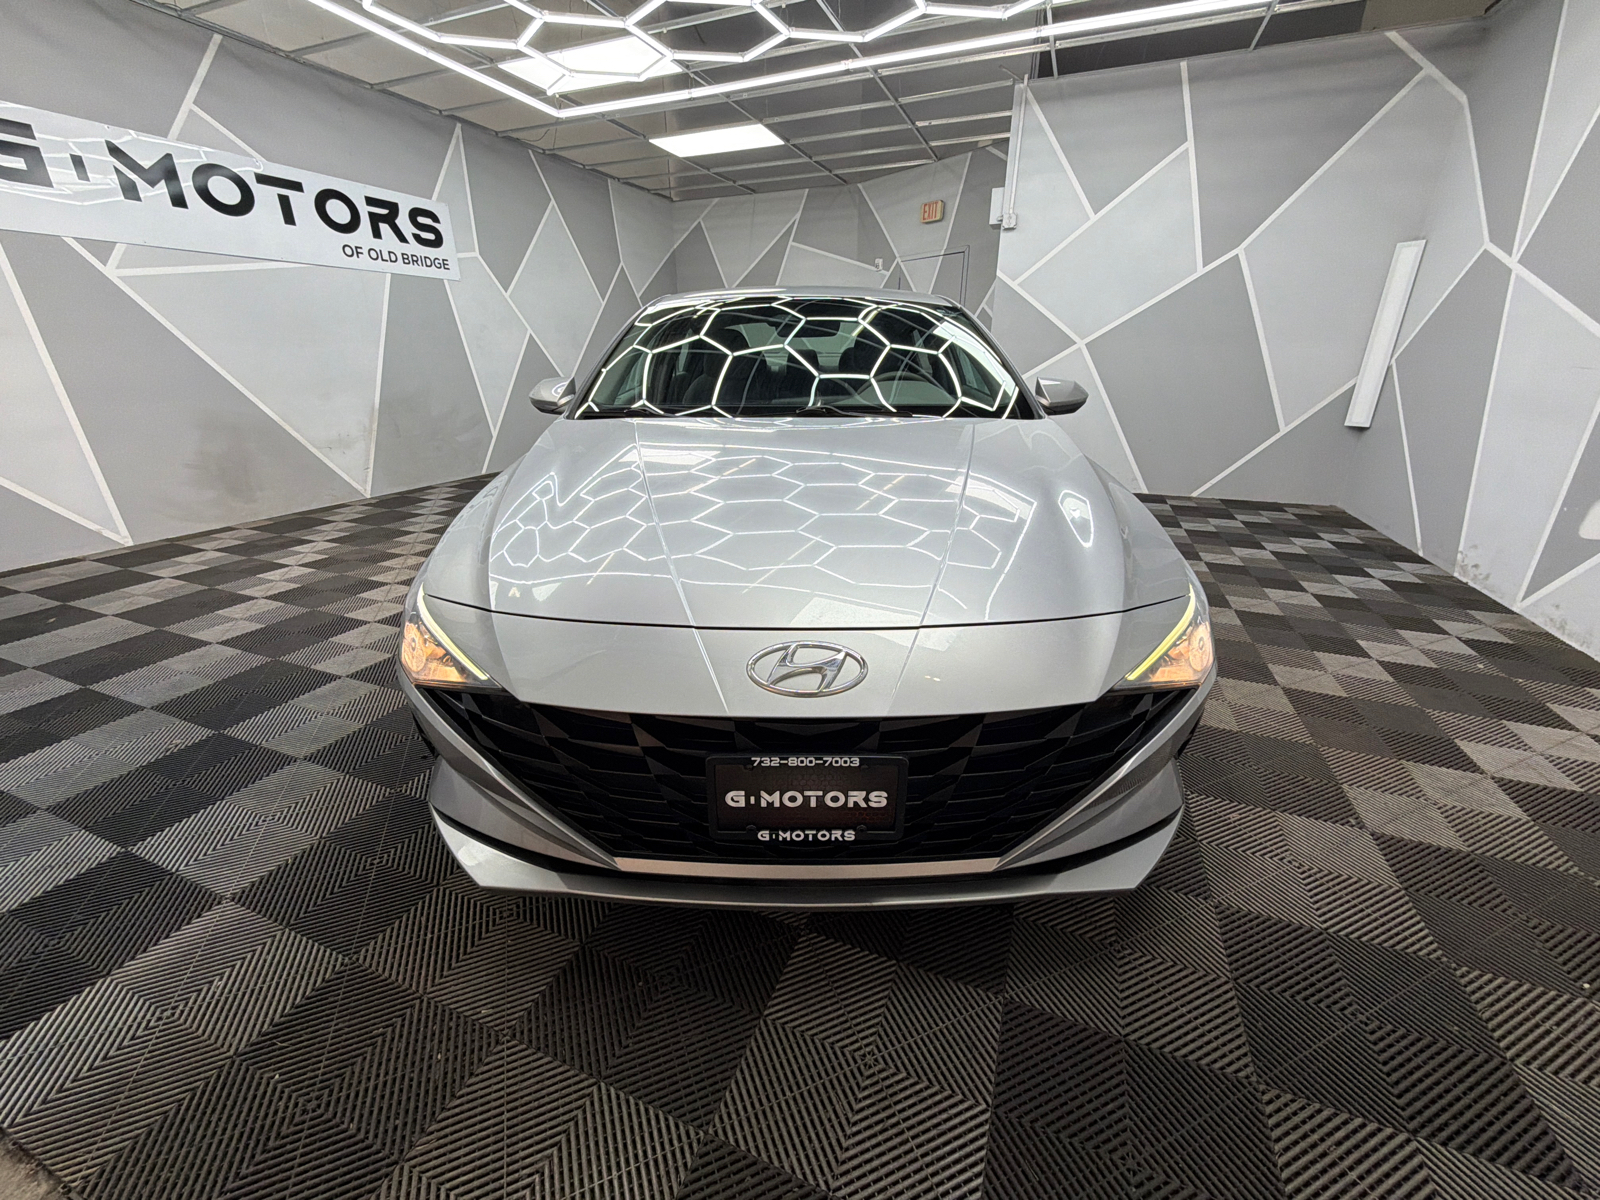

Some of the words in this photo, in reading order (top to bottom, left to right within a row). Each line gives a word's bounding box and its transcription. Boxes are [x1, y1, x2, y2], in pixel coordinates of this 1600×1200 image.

[922, 201, 939, 221] EXIT
[342, 244, 364, 259] OF
[367, 247, 398, 264] OLD
[400, 252, 451, 271] BRIDGE
[751, 757, 860, 767] 732-800-7003
